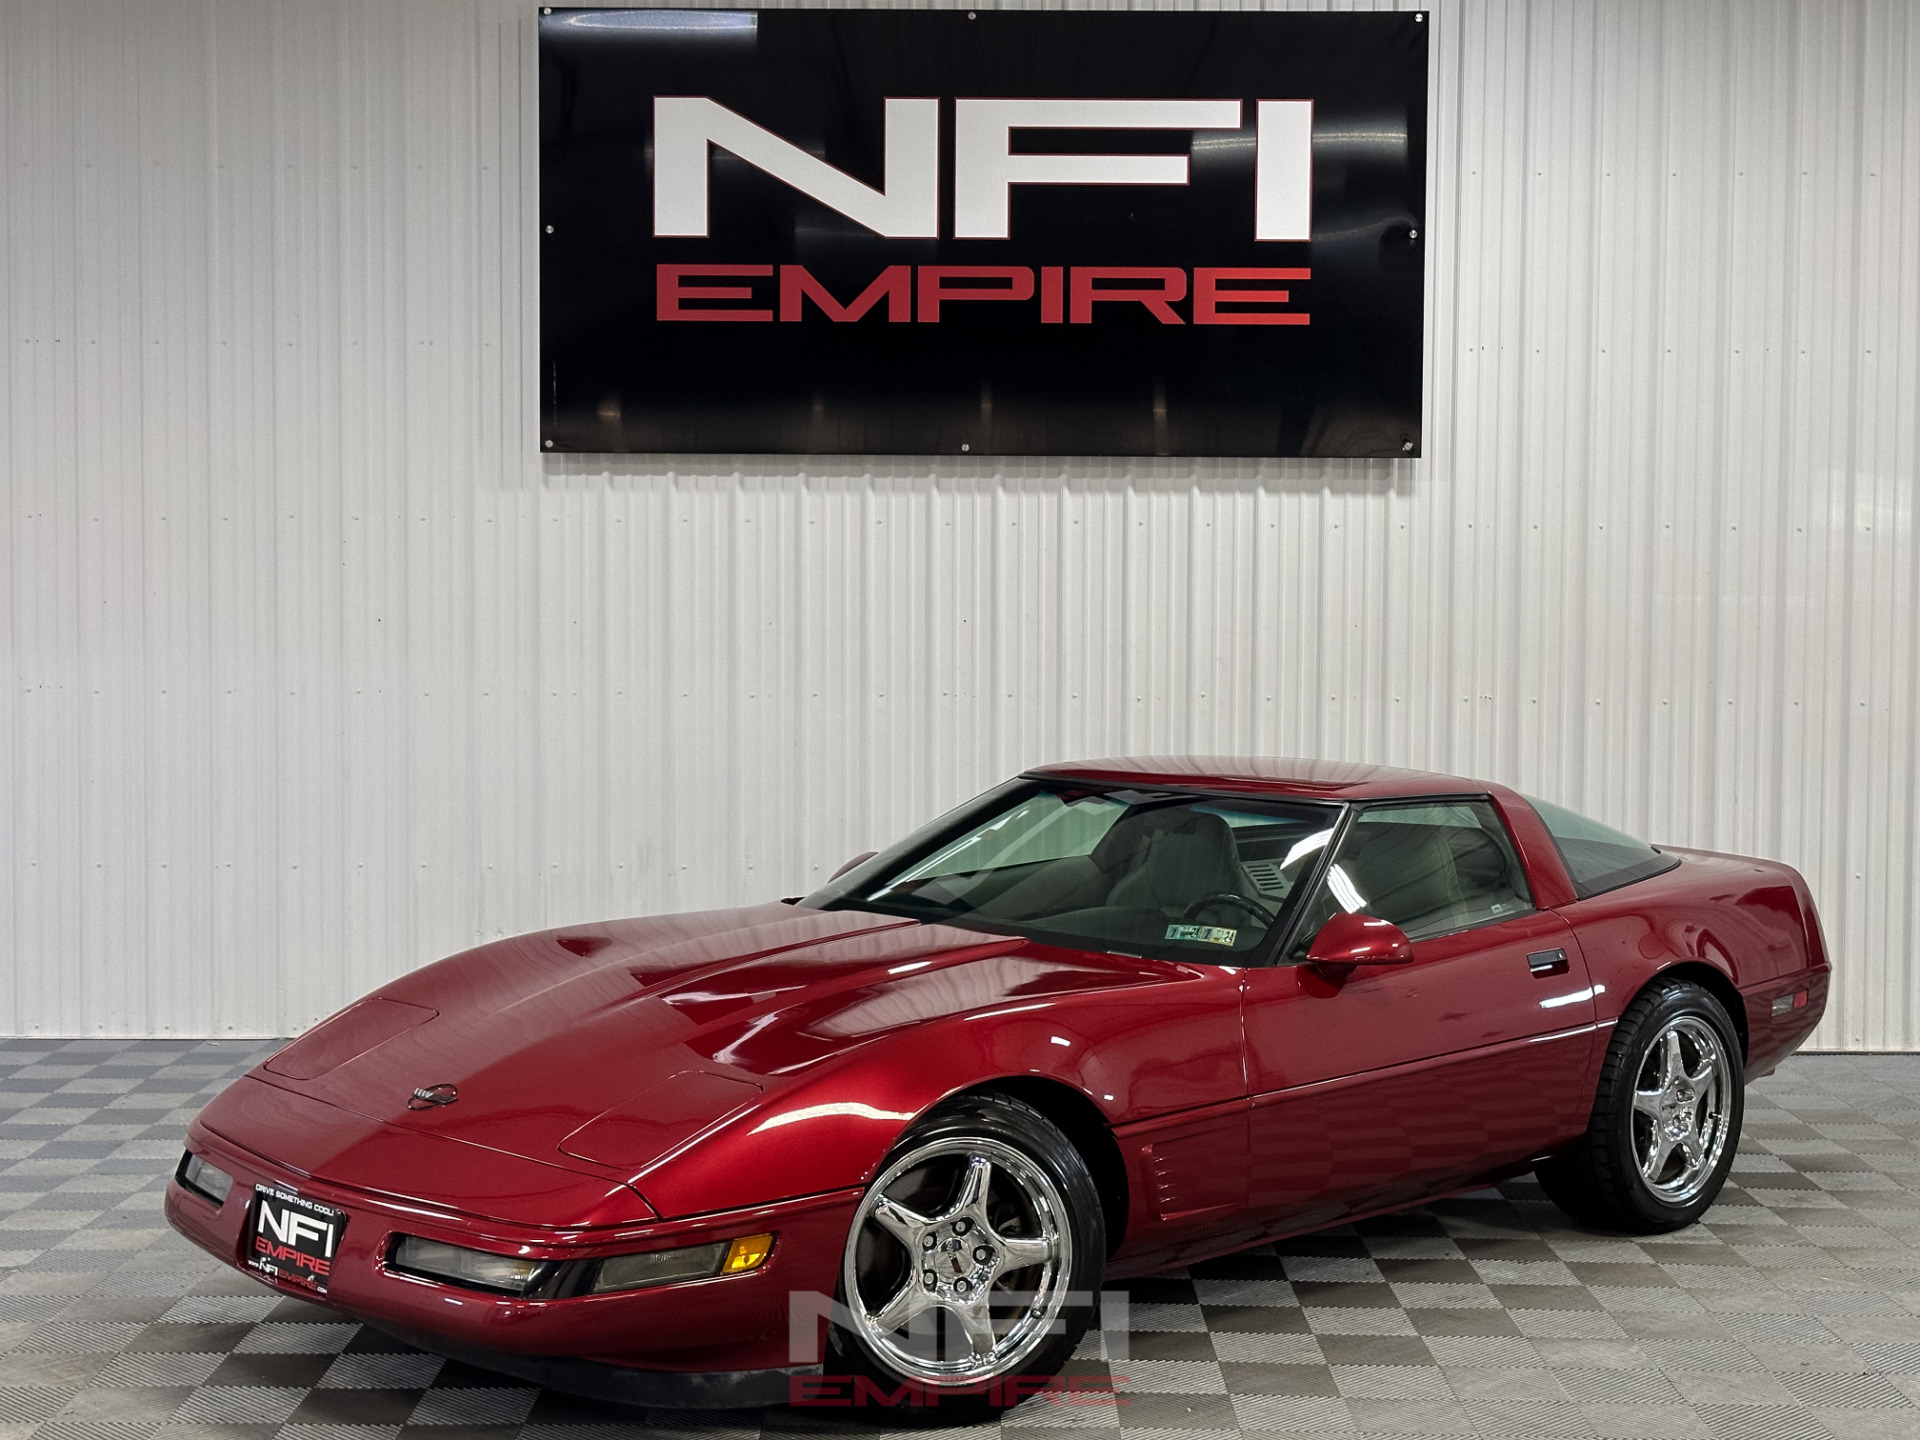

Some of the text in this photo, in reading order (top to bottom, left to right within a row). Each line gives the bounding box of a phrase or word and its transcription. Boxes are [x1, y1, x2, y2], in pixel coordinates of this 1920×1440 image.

[652, 94, 1314, 242] NFI
[656, 264, 1311, 326] EMPIRE
[255, 1184, 275, 1196] DRIVE
[275, 1190, 313, 1210] SOMETHING
[255, 1236, 331, 1275] EMPIRE
[257, 1200, 334, 1258] NFI
